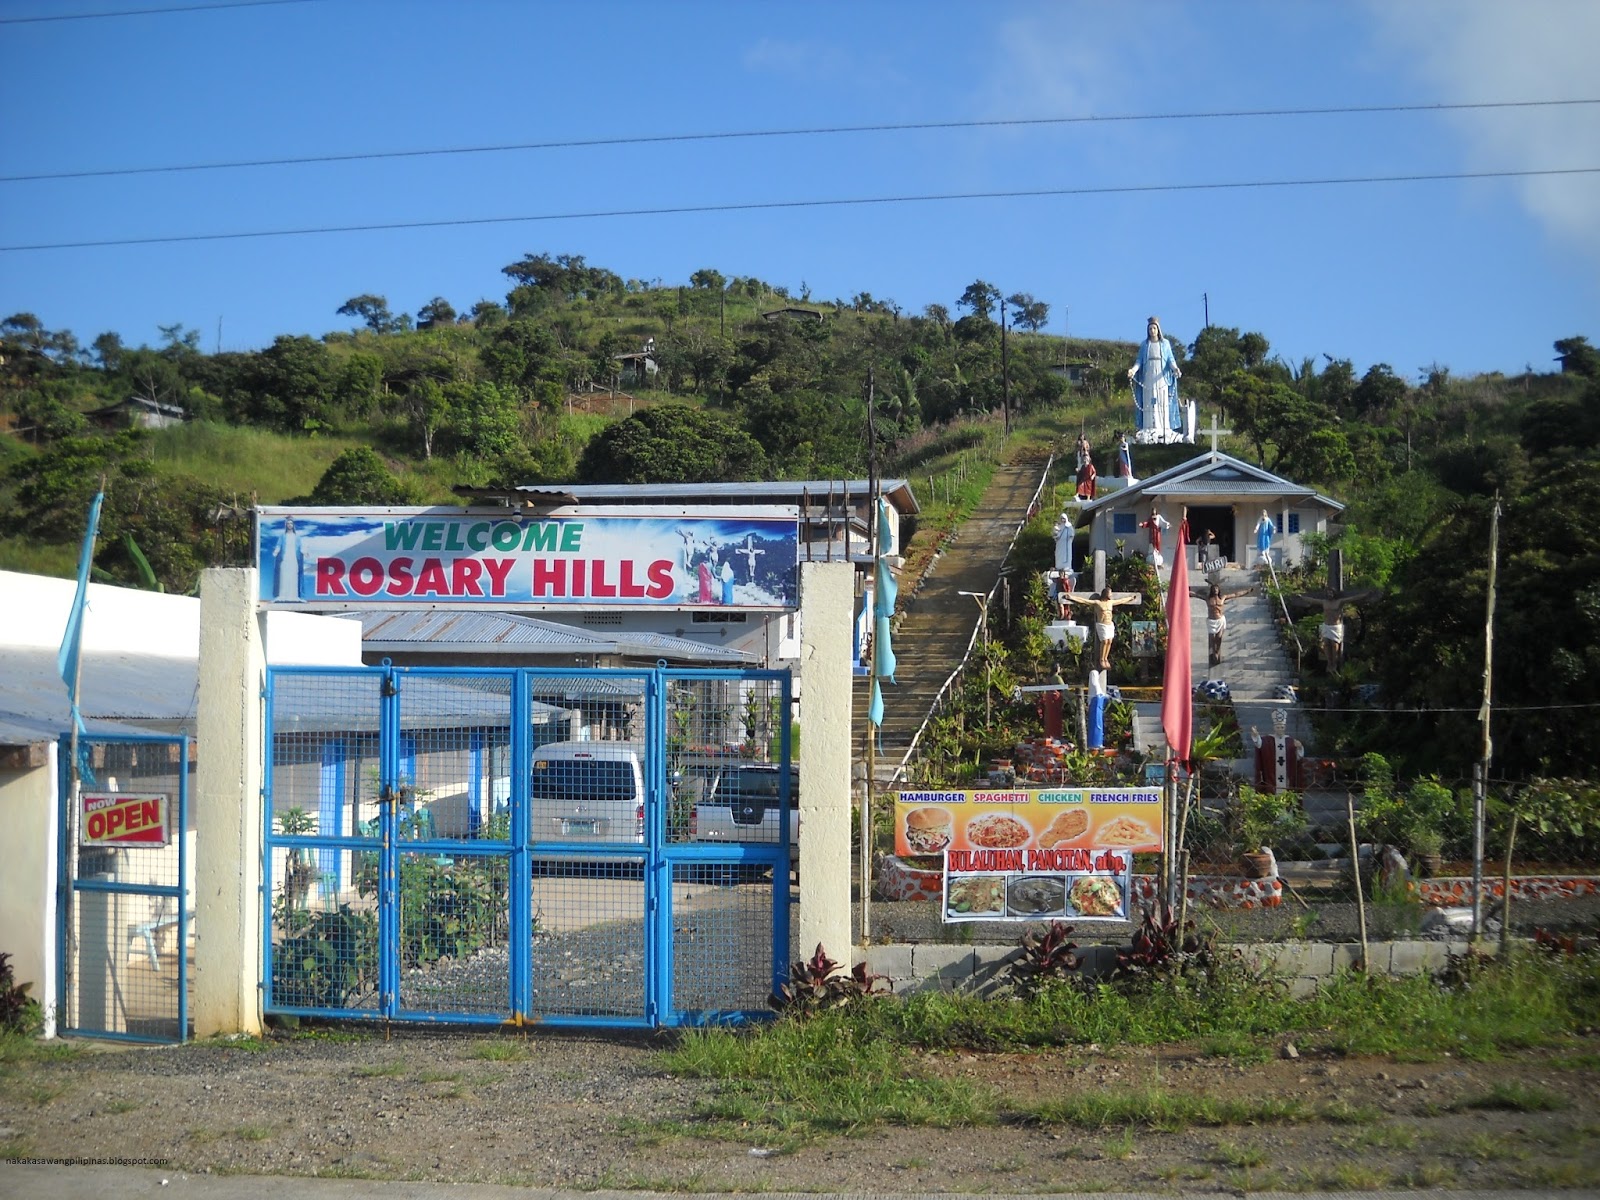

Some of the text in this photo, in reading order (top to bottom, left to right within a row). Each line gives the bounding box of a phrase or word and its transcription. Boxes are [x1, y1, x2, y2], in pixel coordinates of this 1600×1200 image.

[385, 522, 584, 552] WELCOME
[316, 556, 675, 599] ROSARY HILLS
[88, 798, 116, 812] NOW
[900, 793, 1158, 803] HAMBURGER SPAGHETTI CHICKEN FRENCH FRIES
[88, 799, 160, 840] OPEN
[948, 850, 1025, 873] BULALUHAN,
[1028, 849, 1093, 873] PANCITAN,
